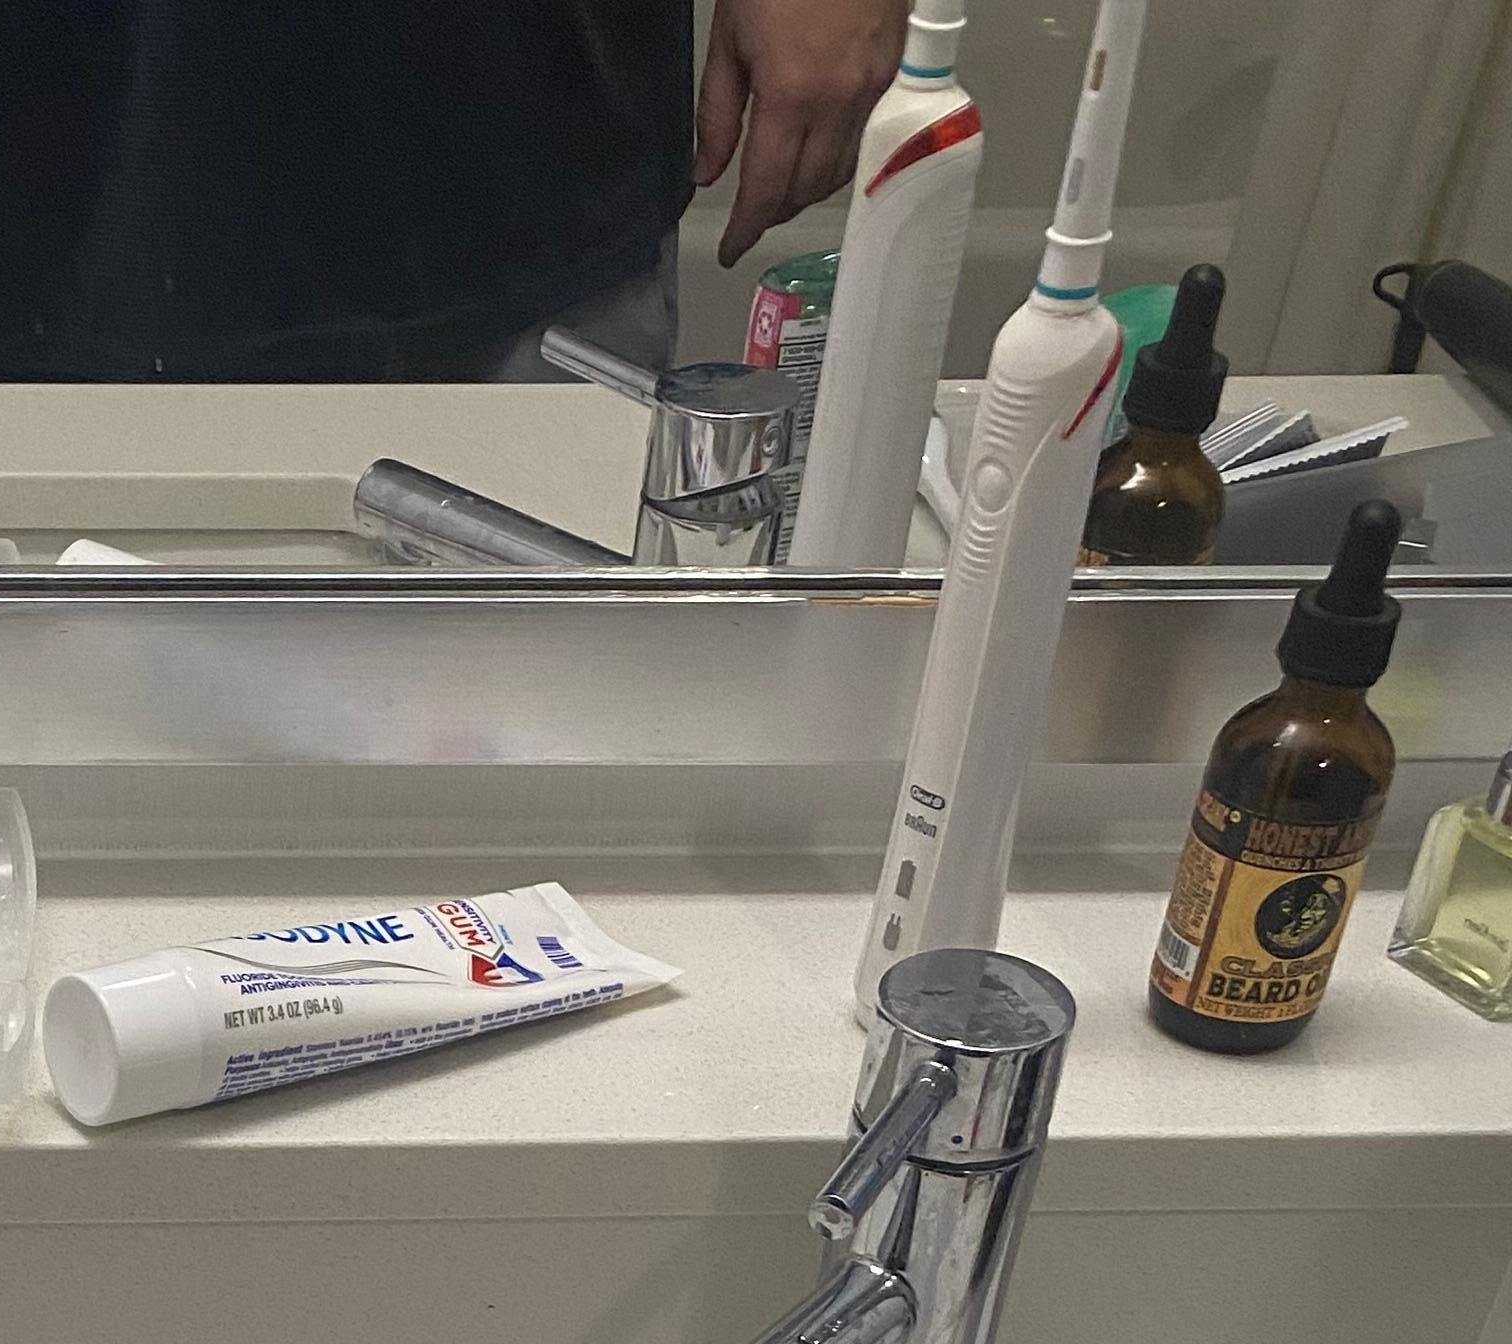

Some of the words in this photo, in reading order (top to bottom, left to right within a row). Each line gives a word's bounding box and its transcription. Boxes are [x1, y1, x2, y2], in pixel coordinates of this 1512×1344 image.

[437, 904, 486, 946] GUM
[1208, 972, 1301, 1003] BEARD
[224, 1009, 245, 1030] NET
[247, 1006, 266, 1025] WT
[268, 1003, 285, 1022] 3.4
[287, 1000, 302, 1018] OZ
